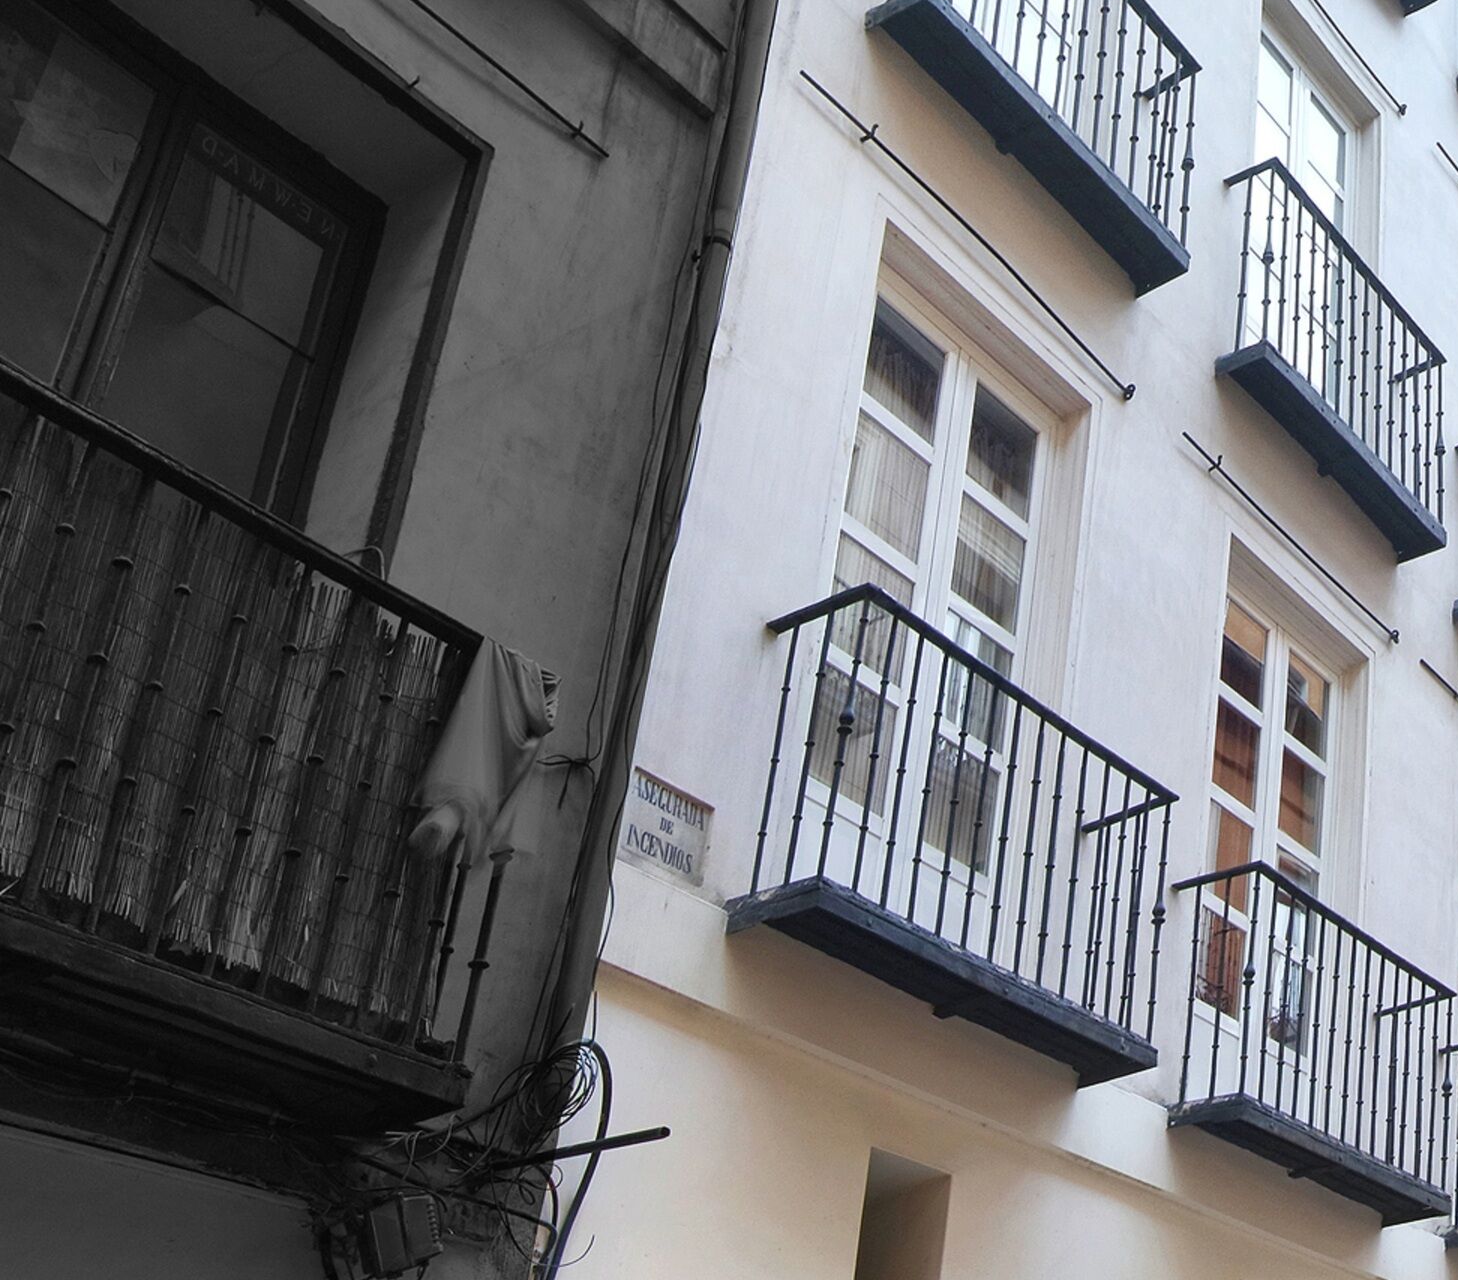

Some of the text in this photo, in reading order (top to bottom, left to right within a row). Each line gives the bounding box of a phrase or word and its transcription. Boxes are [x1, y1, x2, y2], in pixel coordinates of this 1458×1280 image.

[632, 775, 705, 832] ASEGURADA
[659, 817, 674, 836] DE
[627, 823, 693, 874] INCENDIOS
